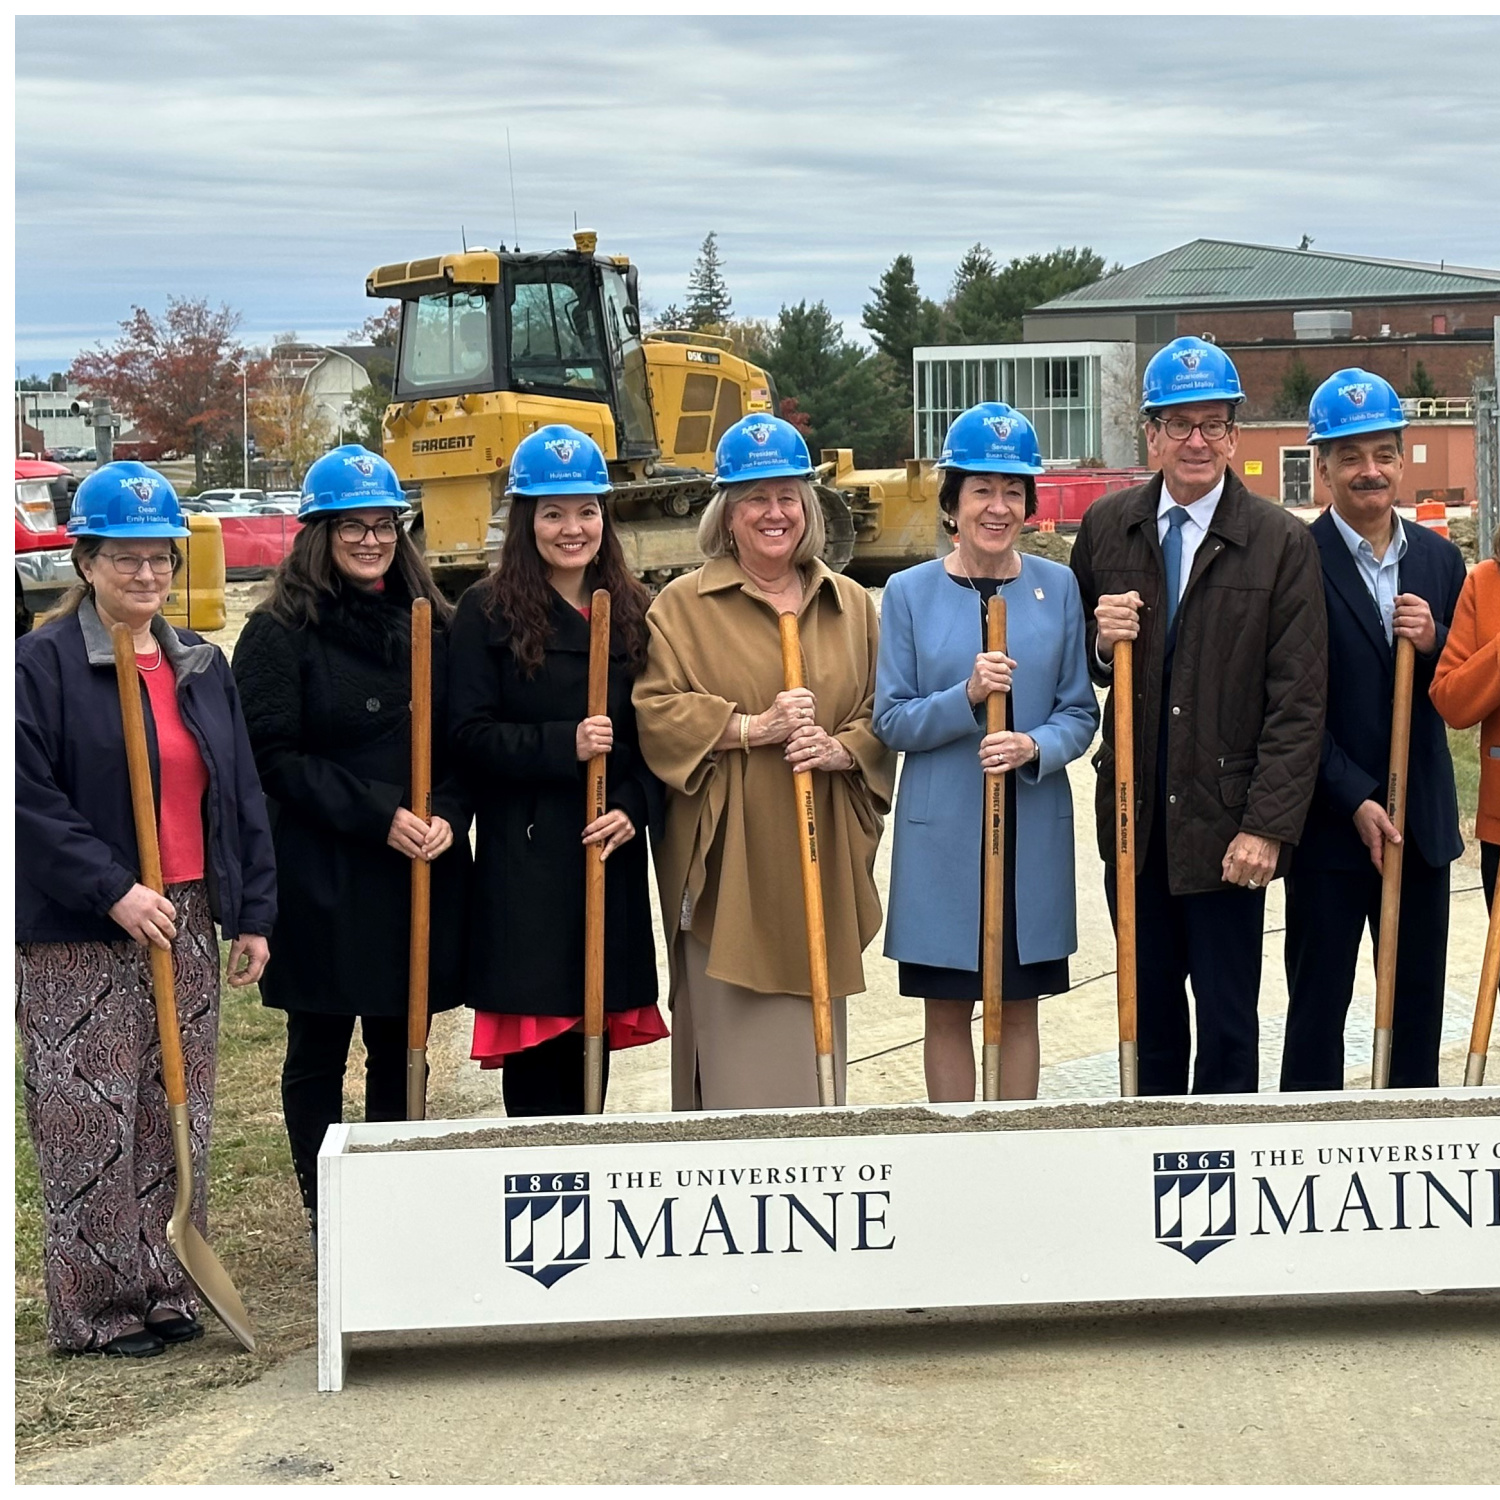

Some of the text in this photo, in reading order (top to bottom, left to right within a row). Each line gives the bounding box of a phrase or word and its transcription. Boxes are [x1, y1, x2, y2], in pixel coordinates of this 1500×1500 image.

[412, 435, 475, 453] SARGENT
[1156, 1150, 1231, 1171] 1865
[1251, 1148, 1305, 1167] THE
[1317, 1143, 1481, 1165] UNIVERSITY
[507, 1173, 586, 1193] 1865
[607, 1164, 893, 1189] THE UNIVERSITY OF
[604, 1190, 896, 1260] MAINE
